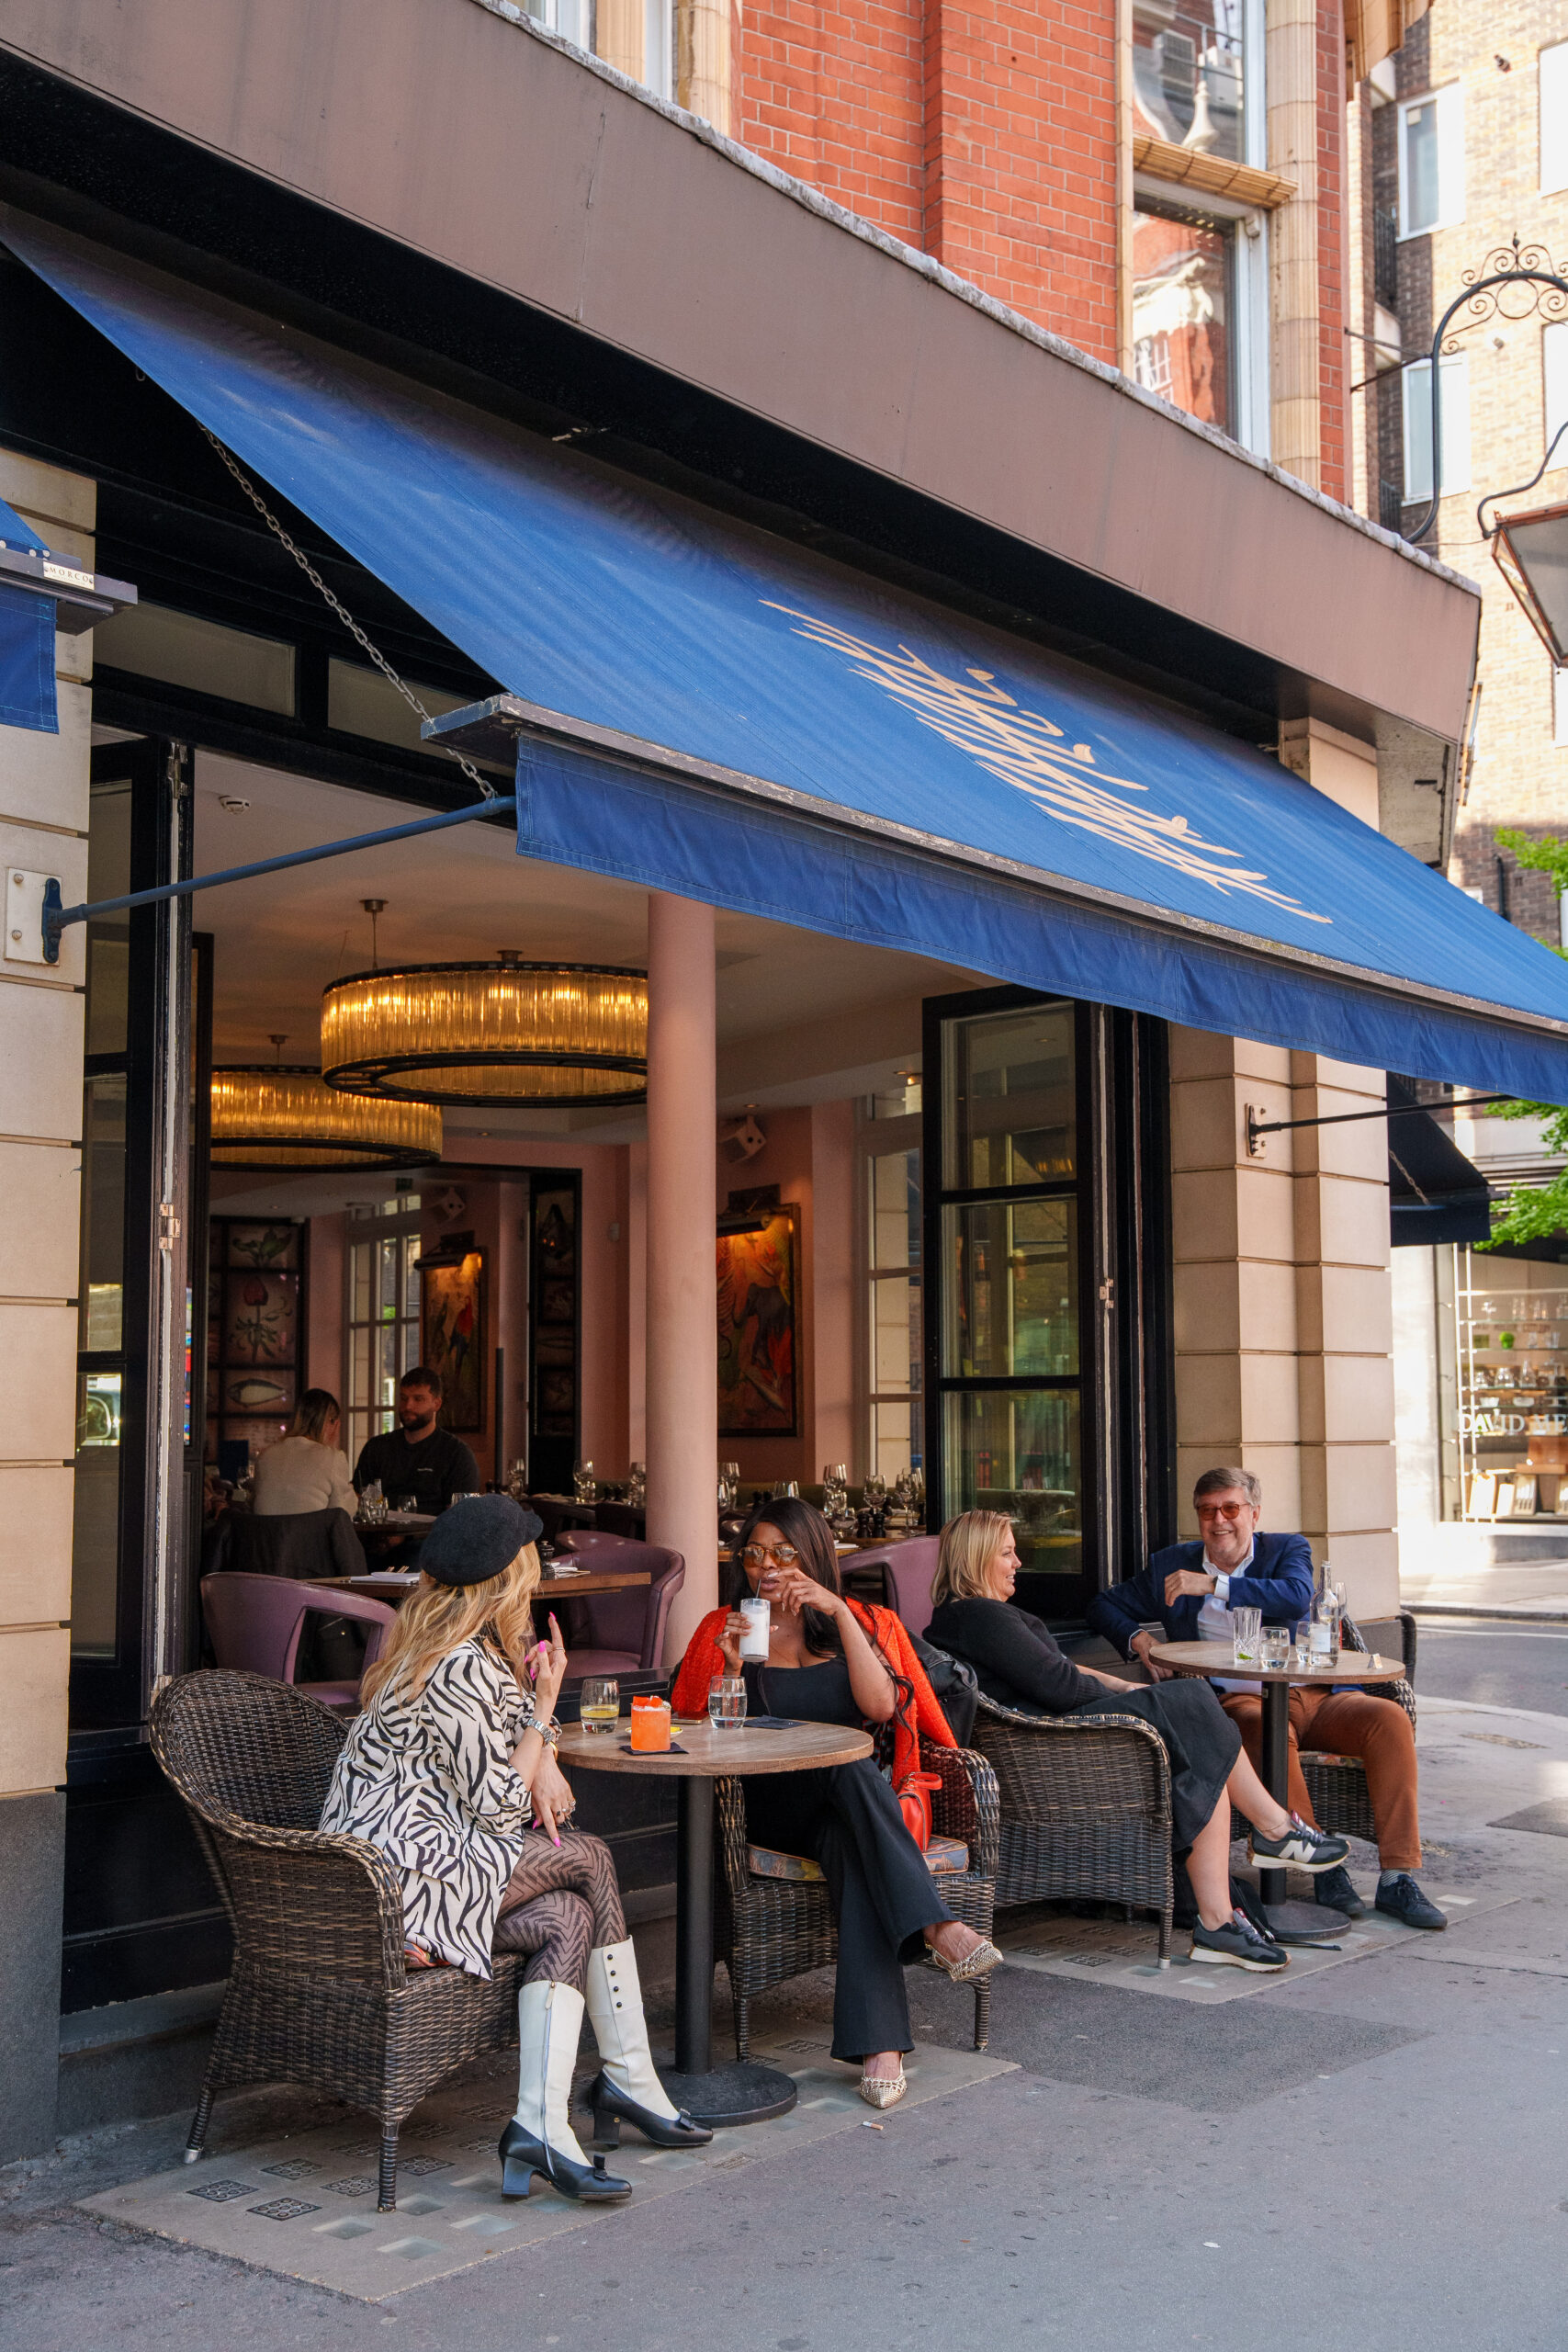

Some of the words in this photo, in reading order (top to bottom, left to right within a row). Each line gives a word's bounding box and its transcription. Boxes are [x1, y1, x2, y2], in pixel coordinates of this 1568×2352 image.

[50, 567, 89, 582] MORCO
[1459, 1413, 1525, 1433] DAVID
[1279, 1839, 1317, 1863] N
